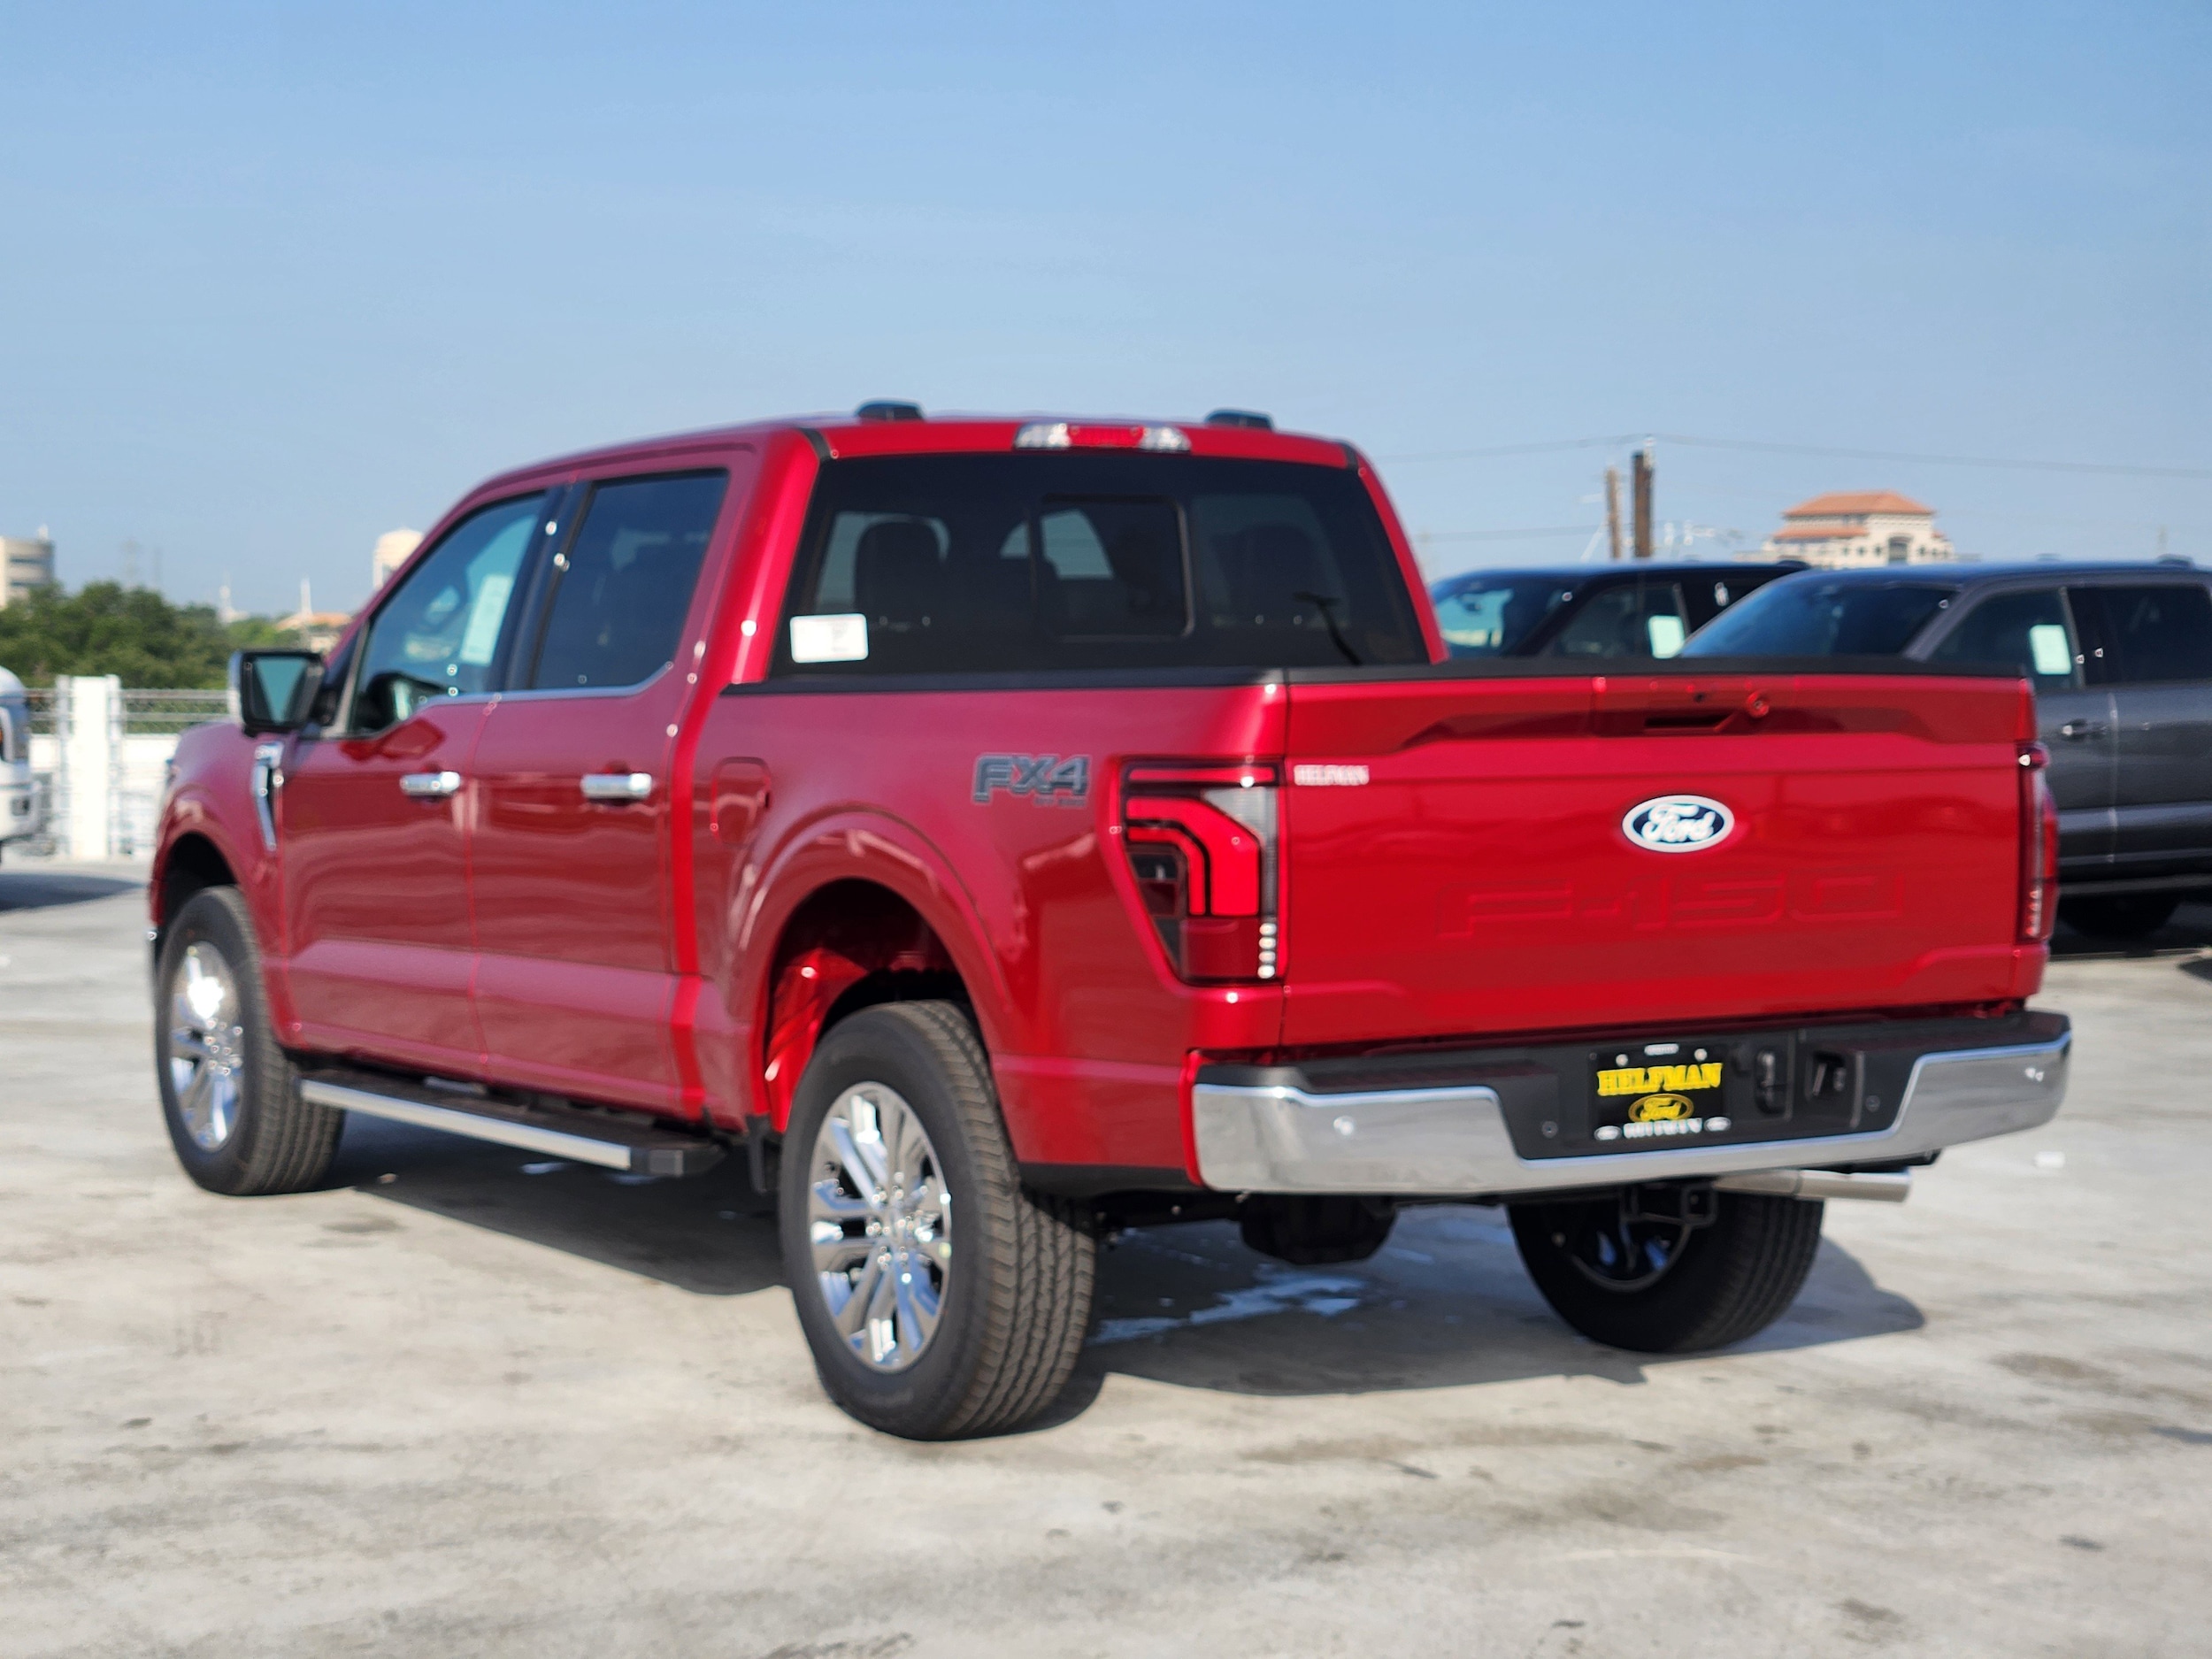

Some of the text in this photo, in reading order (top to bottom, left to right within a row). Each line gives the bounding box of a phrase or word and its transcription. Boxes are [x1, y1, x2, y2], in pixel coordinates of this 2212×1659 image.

[974, 754, 1088, 803] FX4
[1641, 803, 1717, 842] Ford
[1435, 867, 1905, 940] F-150
[1596, 1062, 1723, 1096] HELFMAN
[1640, 1097, 1682, 1122] Ford
